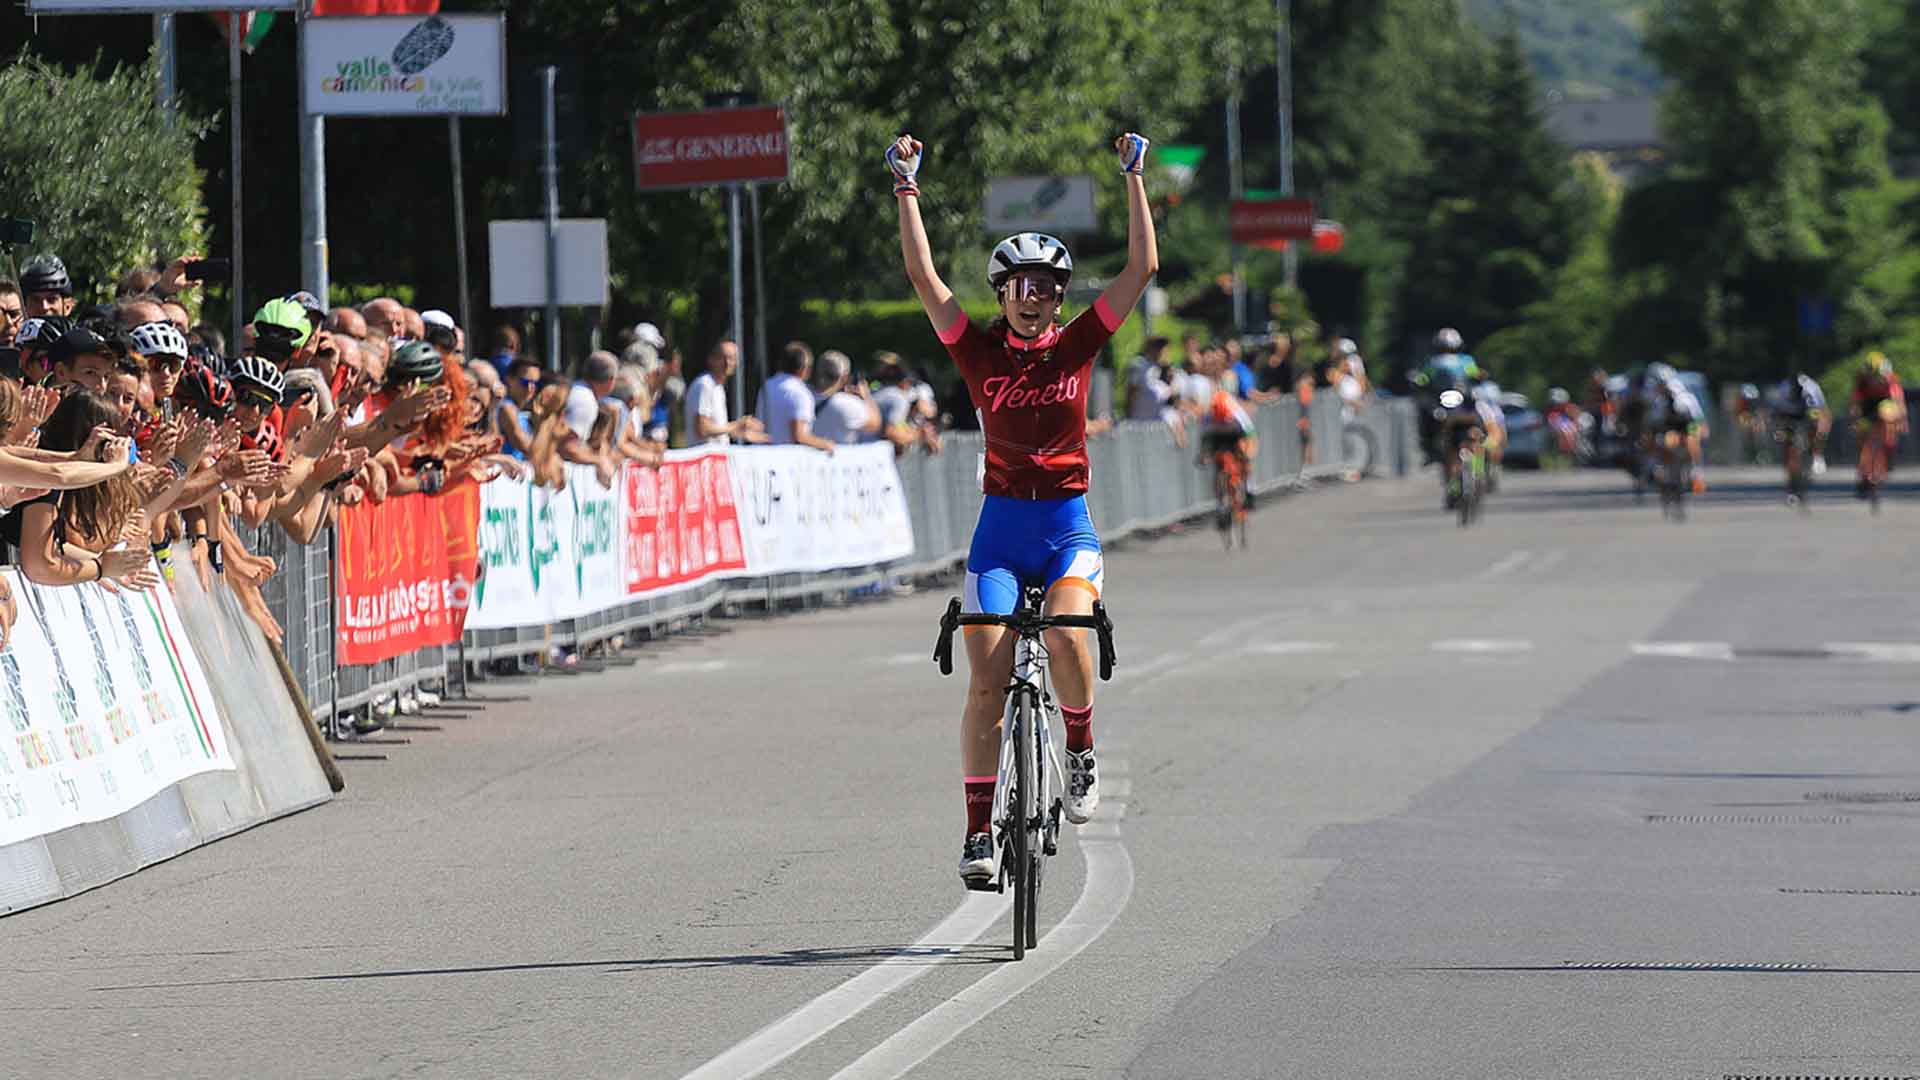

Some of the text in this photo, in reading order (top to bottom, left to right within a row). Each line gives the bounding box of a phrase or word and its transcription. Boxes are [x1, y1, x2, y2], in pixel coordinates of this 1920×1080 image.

[336, 56, 390, 77] valle
[321, 76, 425, 93] camonica
[676, 132, 784, 161] GENERALI
[984, 371, 1079, 412] Veneto
